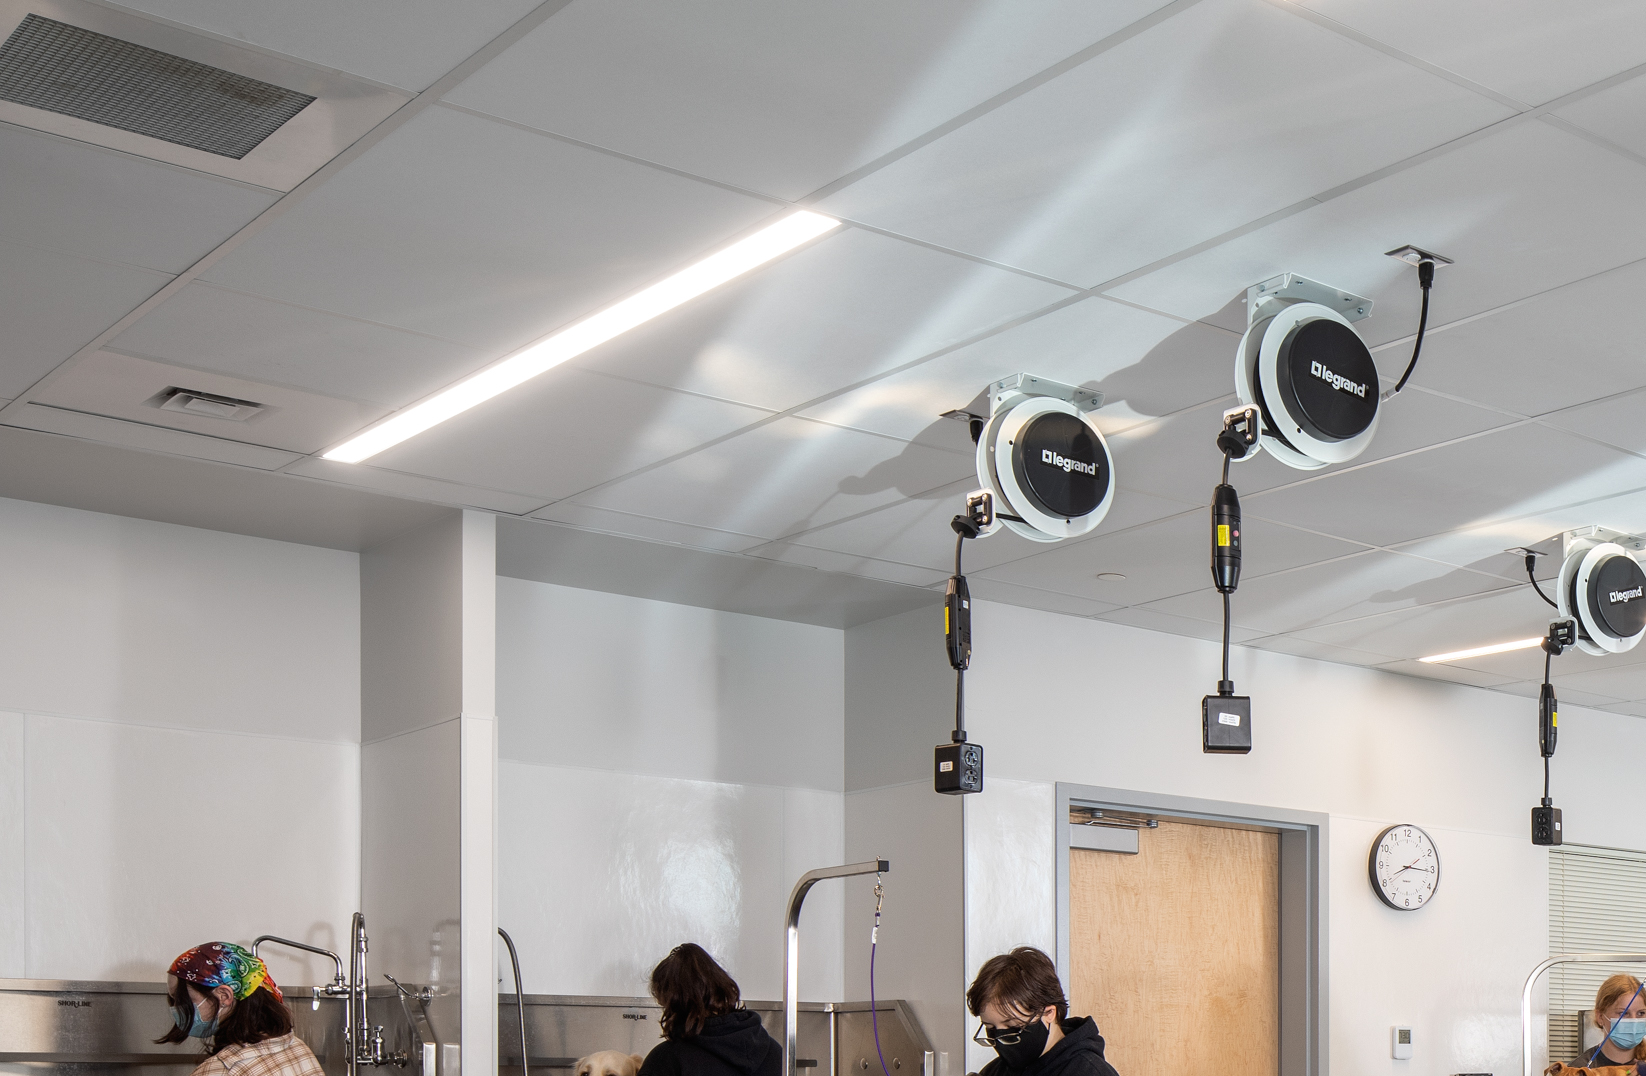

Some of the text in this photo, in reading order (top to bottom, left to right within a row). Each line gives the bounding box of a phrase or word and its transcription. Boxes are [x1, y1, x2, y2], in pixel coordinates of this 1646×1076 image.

[1322, 365, 1366, 398] legrand
[1053, 451, 1096, 476] legrand
[1616, 586, 1642, 602] legrand
[1391, 833, 1397, 841] 11
[58, 1000, 92, 1008] SHOR-LINE
